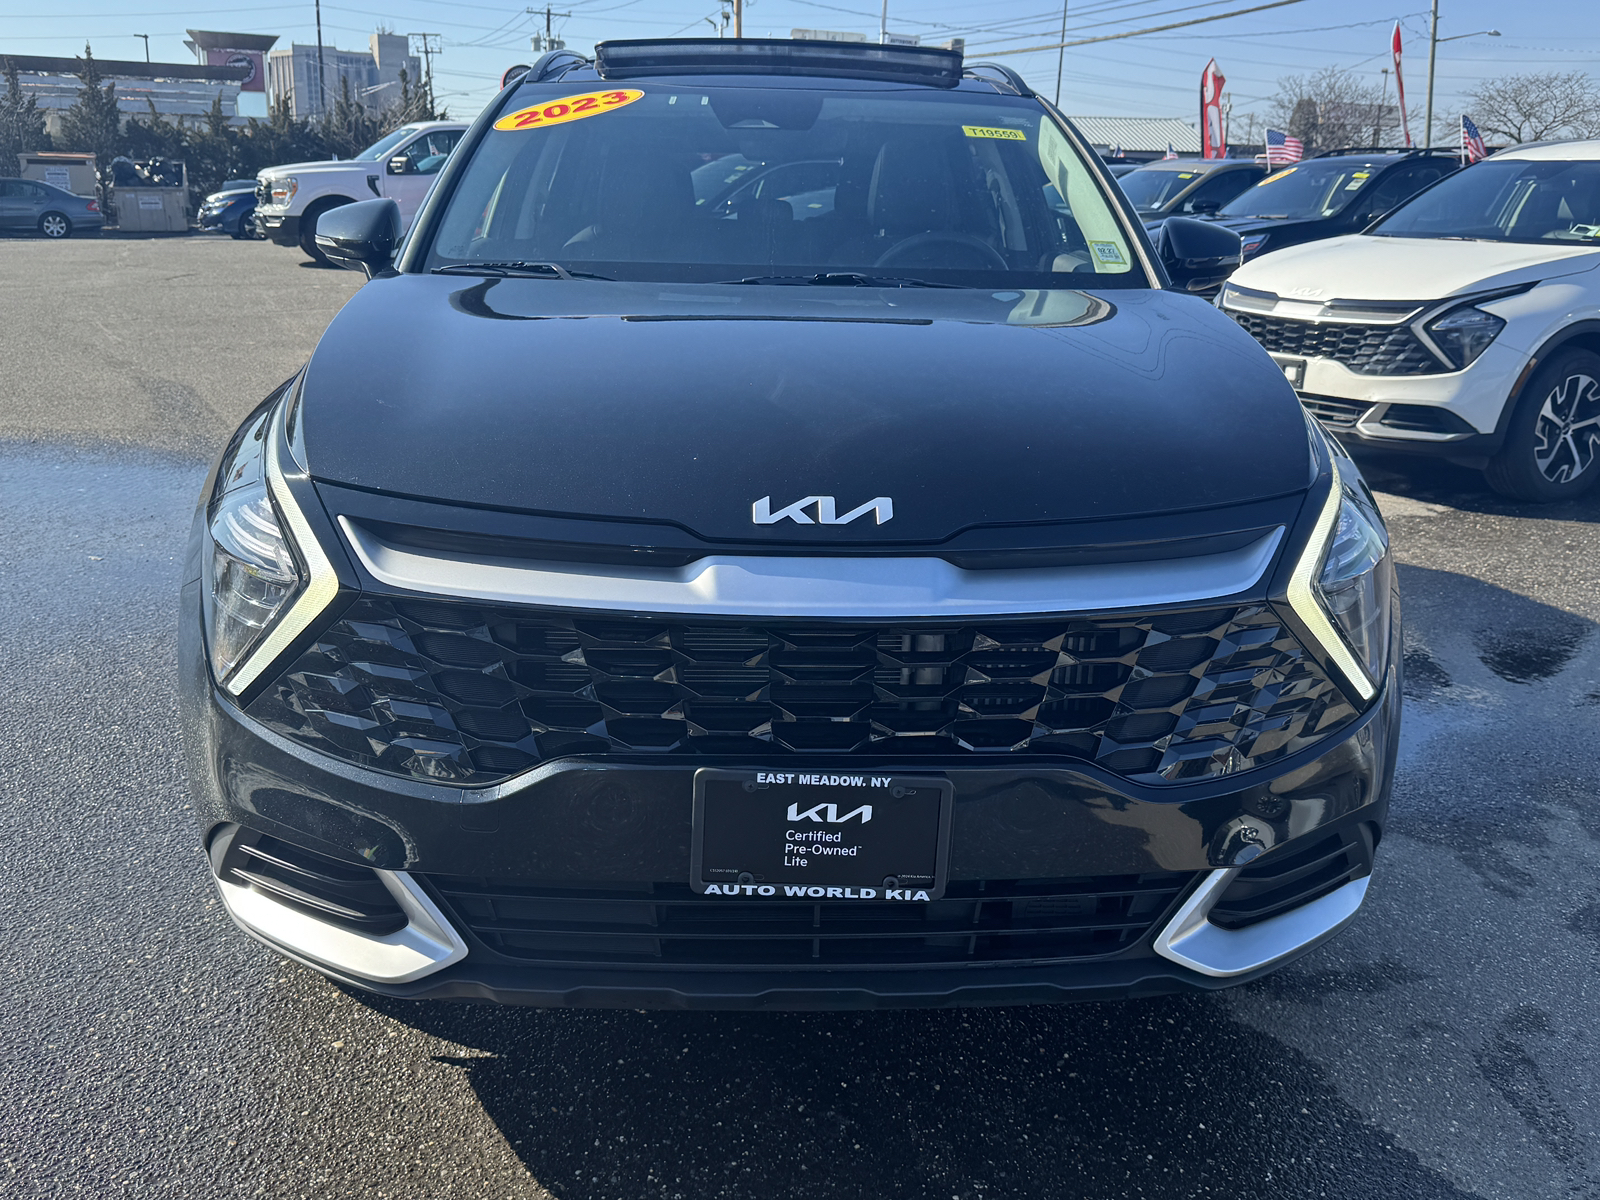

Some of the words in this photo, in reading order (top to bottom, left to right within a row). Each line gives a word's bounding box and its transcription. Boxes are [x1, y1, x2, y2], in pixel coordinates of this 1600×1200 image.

[514, 91, 630, 127] 2023
[752, 495, 894, 525] KIA
[757, 773, 795, 784] EAST
[871, 778, 892, 788] NY
[787, 802, 873, 824] KIA
[785, 830, 842, 842] Certified
[784, 856, 808, 867] Lite
[704, 884, 776, 896] AUTO
[784, 885, 876, 899] WORLD
[885, 889, 931, 901] KIA
